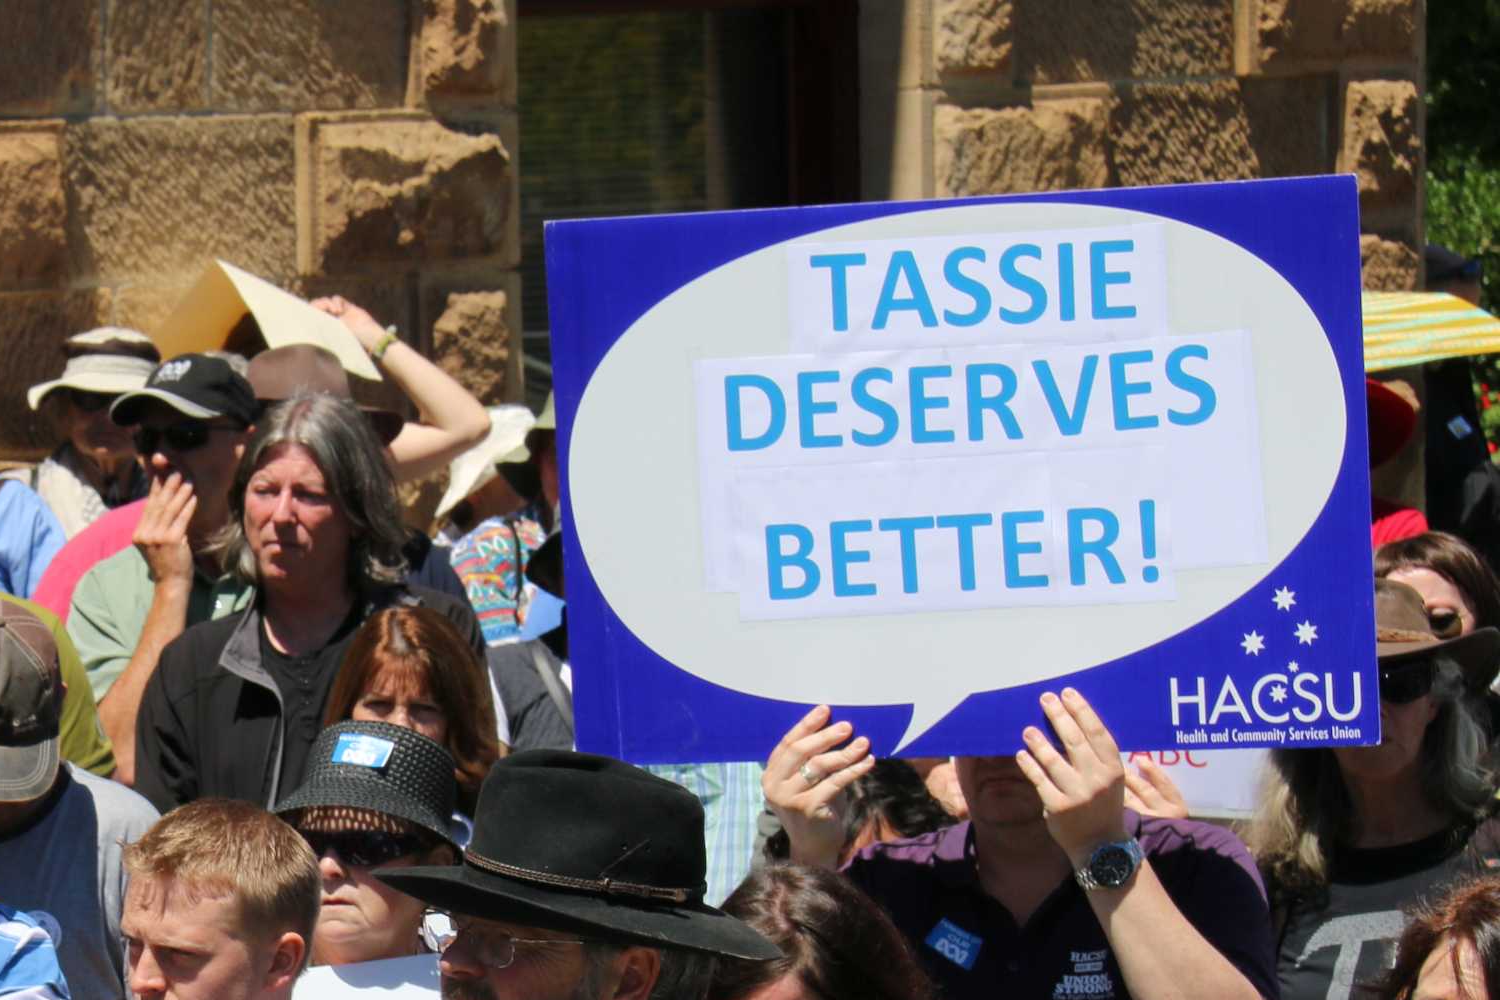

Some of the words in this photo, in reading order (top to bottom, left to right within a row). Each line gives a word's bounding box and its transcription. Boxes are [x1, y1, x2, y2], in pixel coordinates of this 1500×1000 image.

[810, 239, 1137, 332] TASSIE
[724, 344, 1217, 452] DESERVES
[765, 499, 1160, 601] BETTER!
[1169, 671, 1363, 726] HACSU
[1176, 728, 1208, 744] Health
[1211, 729, 1229, 743] and
[1232, 727, 1286, 746] Community
[1289, 727, 1329, 741] Services
[1332, 726, 1361, 740] Union
